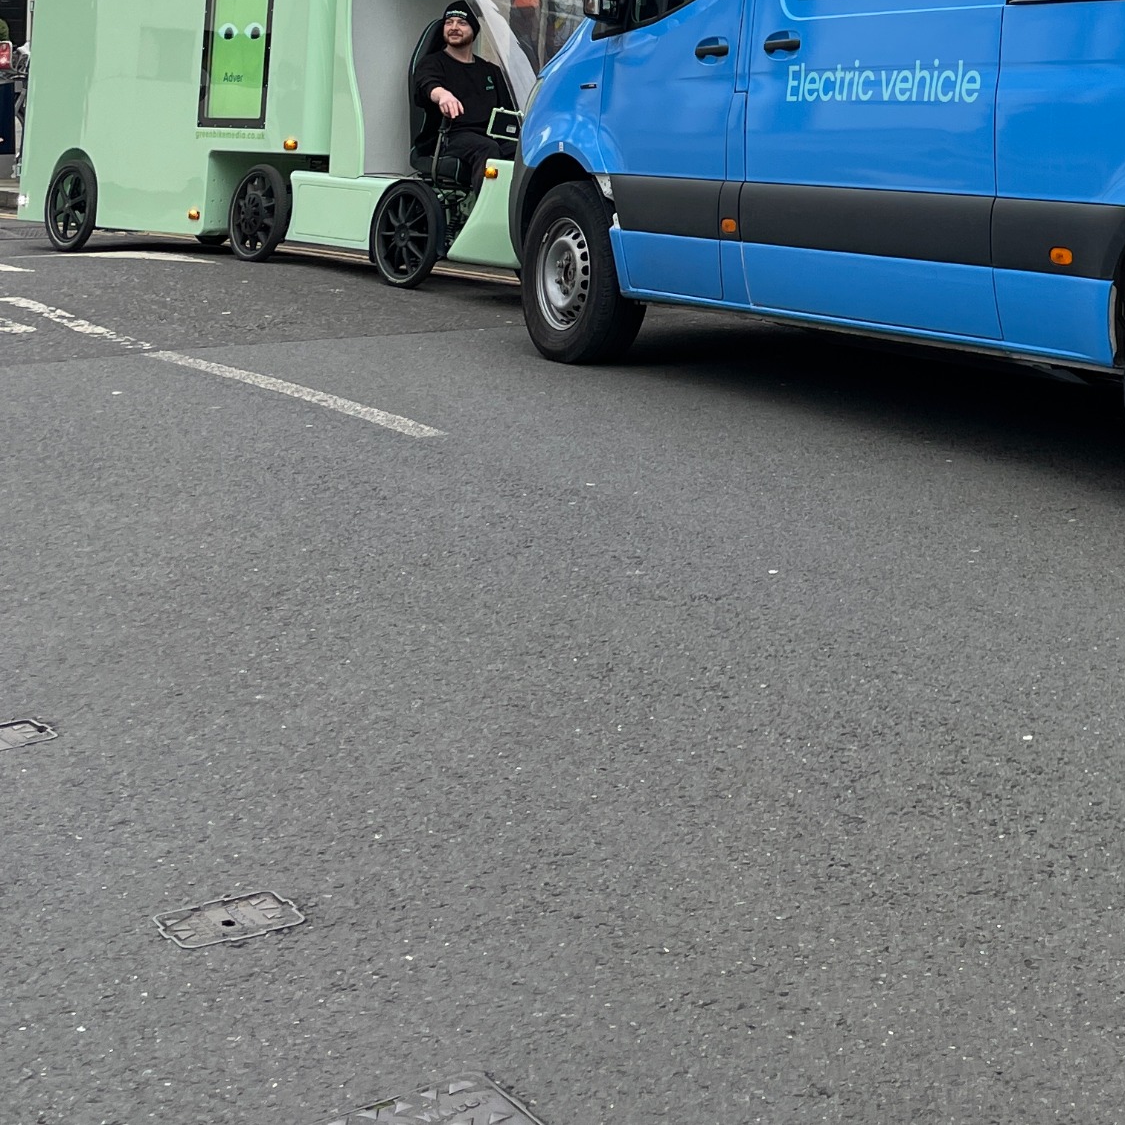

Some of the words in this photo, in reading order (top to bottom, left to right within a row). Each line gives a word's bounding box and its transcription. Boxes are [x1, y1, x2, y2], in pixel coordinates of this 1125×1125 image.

[223, 72, 243, 82] Adver
[786, 59, 875, 102] Electric
[881, 58, 981, 103] vehicle
